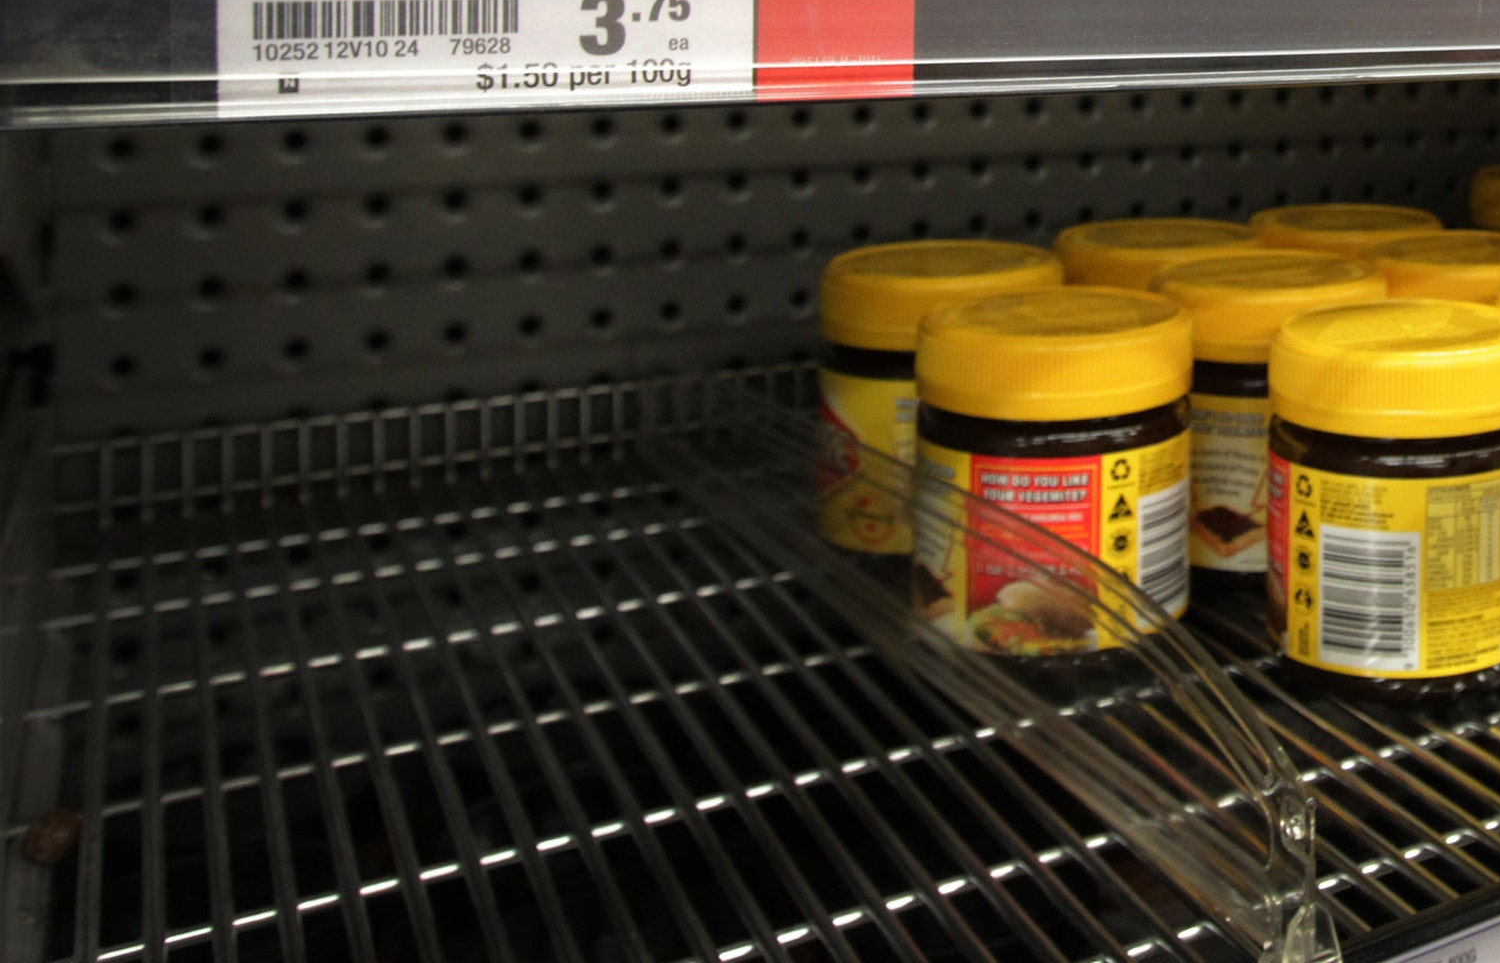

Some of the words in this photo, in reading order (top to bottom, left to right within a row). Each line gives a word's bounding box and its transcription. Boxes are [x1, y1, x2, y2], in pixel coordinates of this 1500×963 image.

[252, 42, 319, 62] 10252
[325, 40, 388, 59] 12V10
[394, 39, 418, 57] 24
[450, 37, 511, 56] 79628
[668, 37, 690, 51] ea
[476, 62, 558, 93] $1.50
[570, 64, 615, 91] per
[626, 58, 691, 87] 100g
[1011, 474, 1030, 488] DO
[1033, 474, 1060, 488] YOU
[1062, 473, 1089, 488] LIKE
